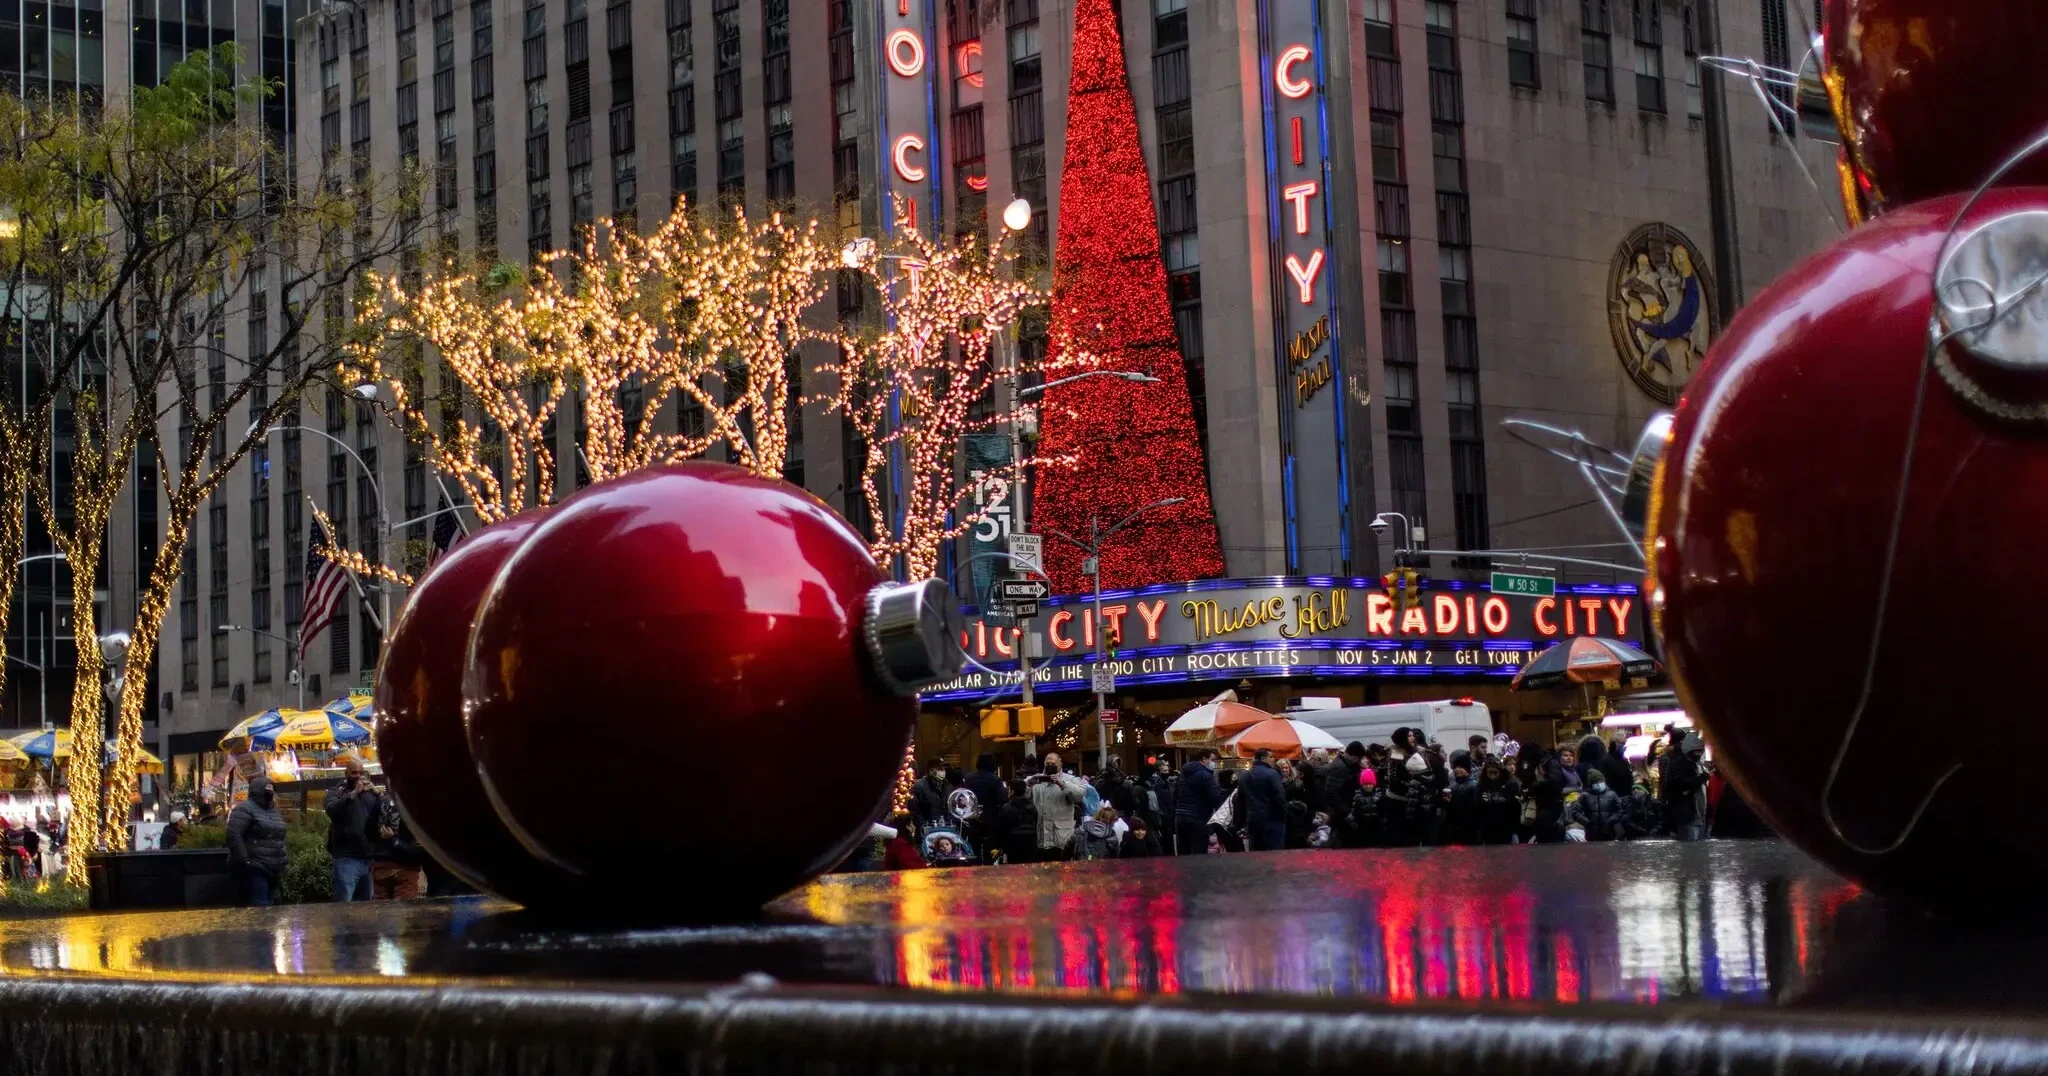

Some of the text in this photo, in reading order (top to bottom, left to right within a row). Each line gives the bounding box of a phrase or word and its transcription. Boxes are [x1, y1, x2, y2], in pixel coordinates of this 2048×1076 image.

[1276, 46, 1325, 305] CITY
[892, 132, 933, 366] CITY
[1289, 315, 1329, 373] MUSIC
[1296, 355, 1332, 408] HALL
[970, 470, 1010, 513] 12
[1025, 536, 1040, 544] BLOCK
[1009, 585, 1043, 595] ONE WAY
[1508, 578, 1538, 592] W 50 St
[1021, 605, 1034, 613] WAY
[1050, 600, 1167, 649] CITY
[1181, 597, 1285, 641] Music
[1279, 588, 1351, 639] Hall
[1366, 594, 1510, 636] RADIO
[1533, 596, 1632, 636] CITY
[1061, 665, 1083, 679] THE
[1142, 657, 1175, 673] CITY
[1187, 650, 1300, 670] ROCKETTES
[1336, 650, 1363, 665] NOV
[1425, 650, 1433, 665] 2
[1455, 650, 1479, 664] GET
[1488, 650, 1520, 664] YOUR
